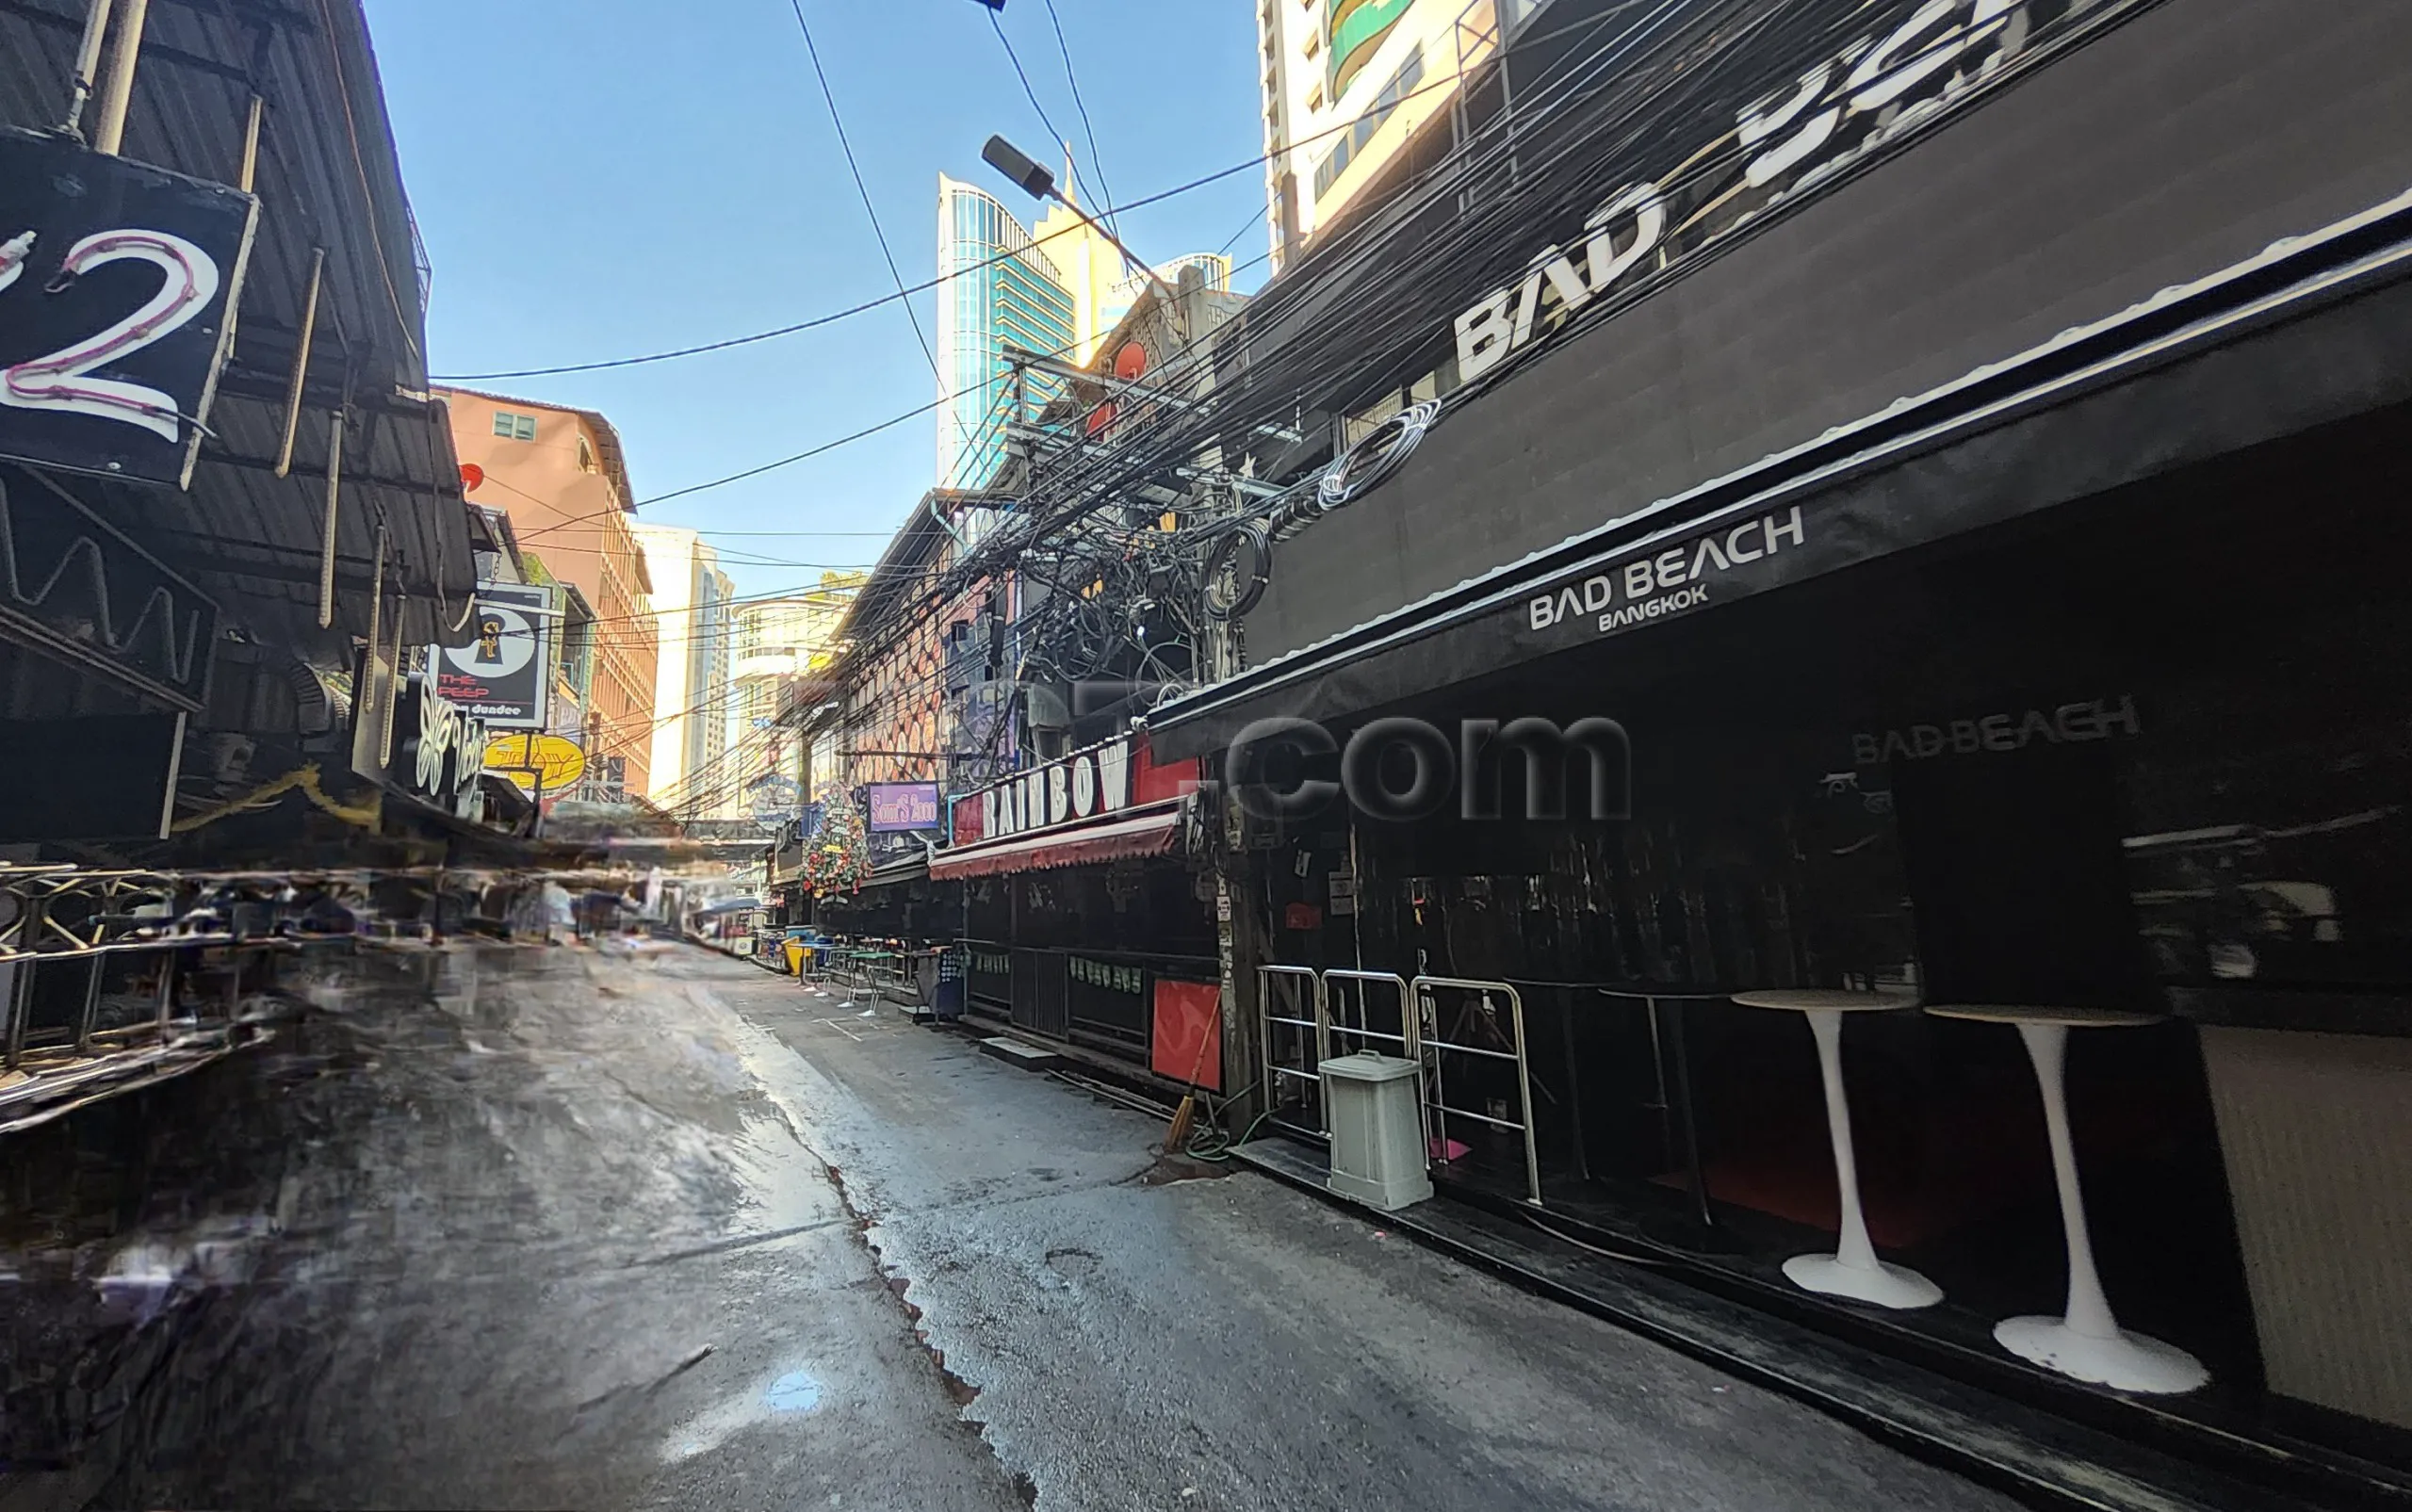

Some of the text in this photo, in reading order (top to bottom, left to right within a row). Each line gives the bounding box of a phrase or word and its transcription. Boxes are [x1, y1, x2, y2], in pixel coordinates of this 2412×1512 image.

[1454, 182, 1667, 382] BAD
[1529, 505, 1804, 631] BAD BEACH
[1598, 583, 1710, 632] BANGKOK
[437, 687, 490, 697] PEEP
[439, 674, 477, 686] THE
[471, 704, 521, 716] dundee
[1852, 691, 2143, 765] BAD BEACH
[983, 740, 1129, 839] RAINBOW
